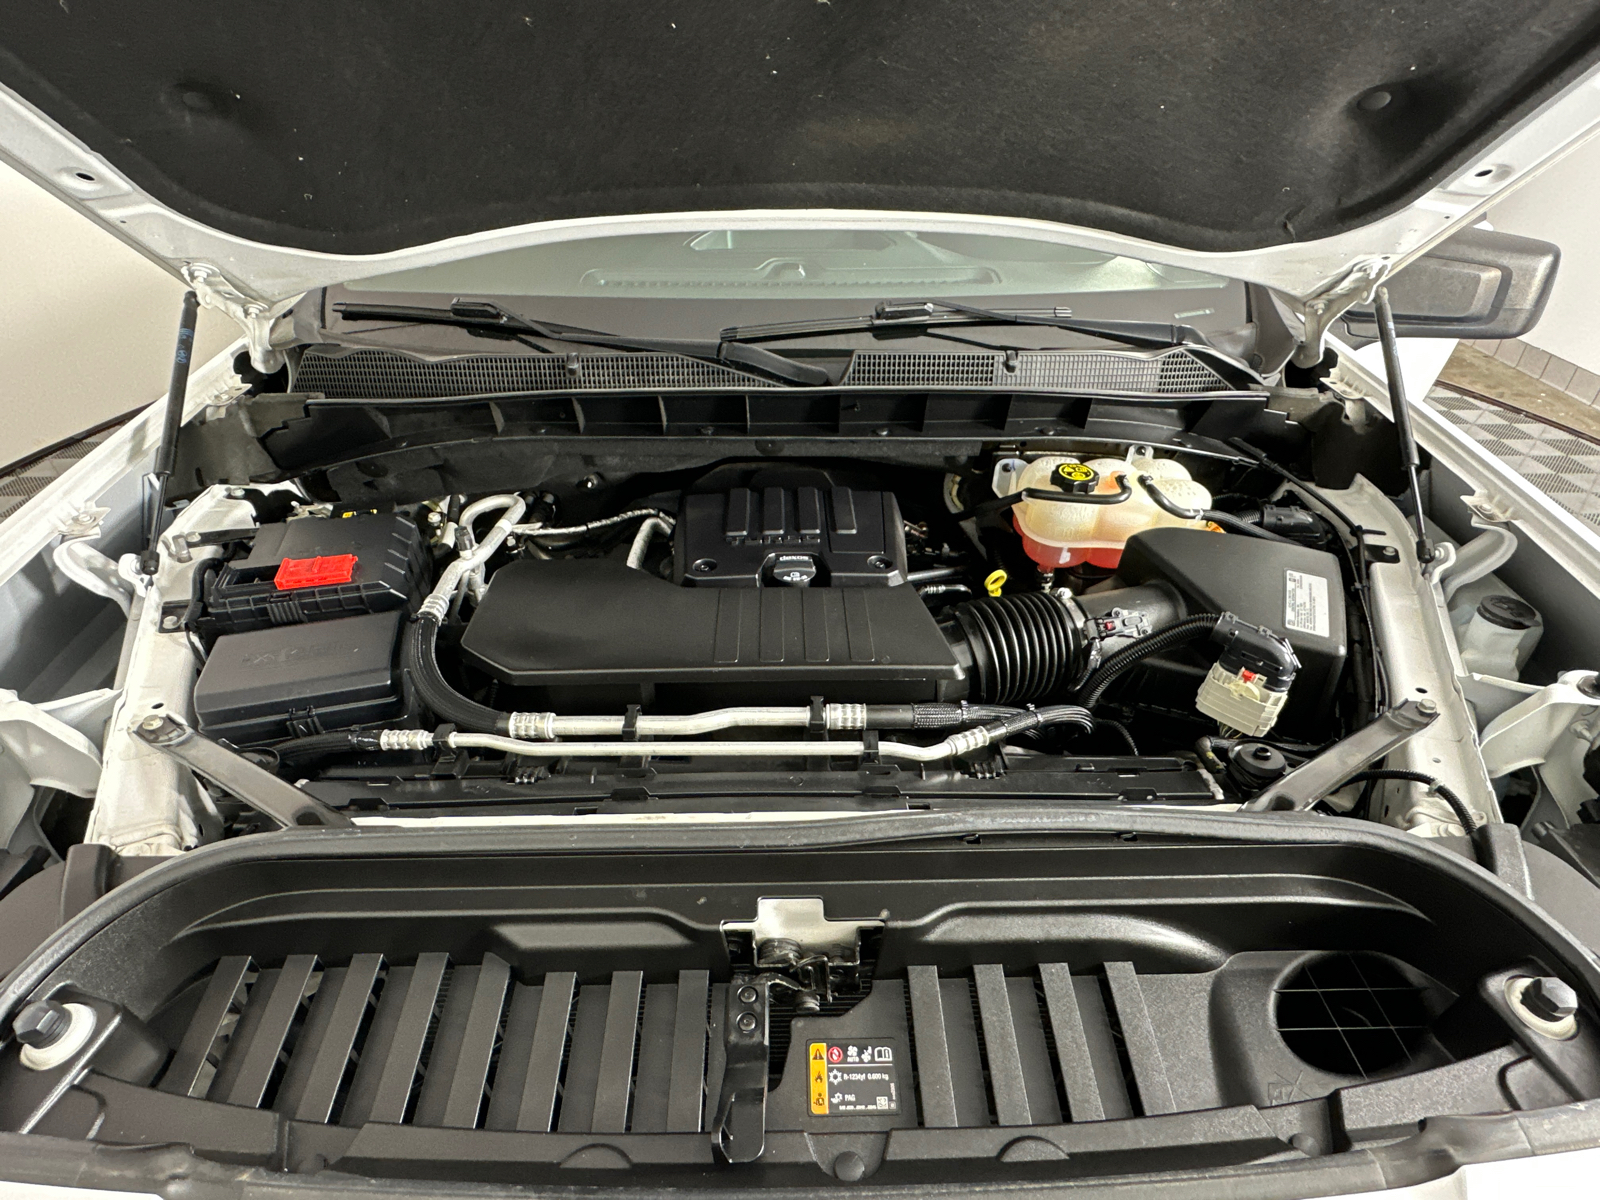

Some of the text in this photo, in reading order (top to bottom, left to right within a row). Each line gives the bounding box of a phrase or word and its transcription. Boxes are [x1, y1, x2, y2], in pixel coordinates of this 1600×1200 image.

[843, 1073, 866, 1081] R-1234yf
[882, 1072, 889, 1081] kg
[844, 1094, 856, 1102] PAG
